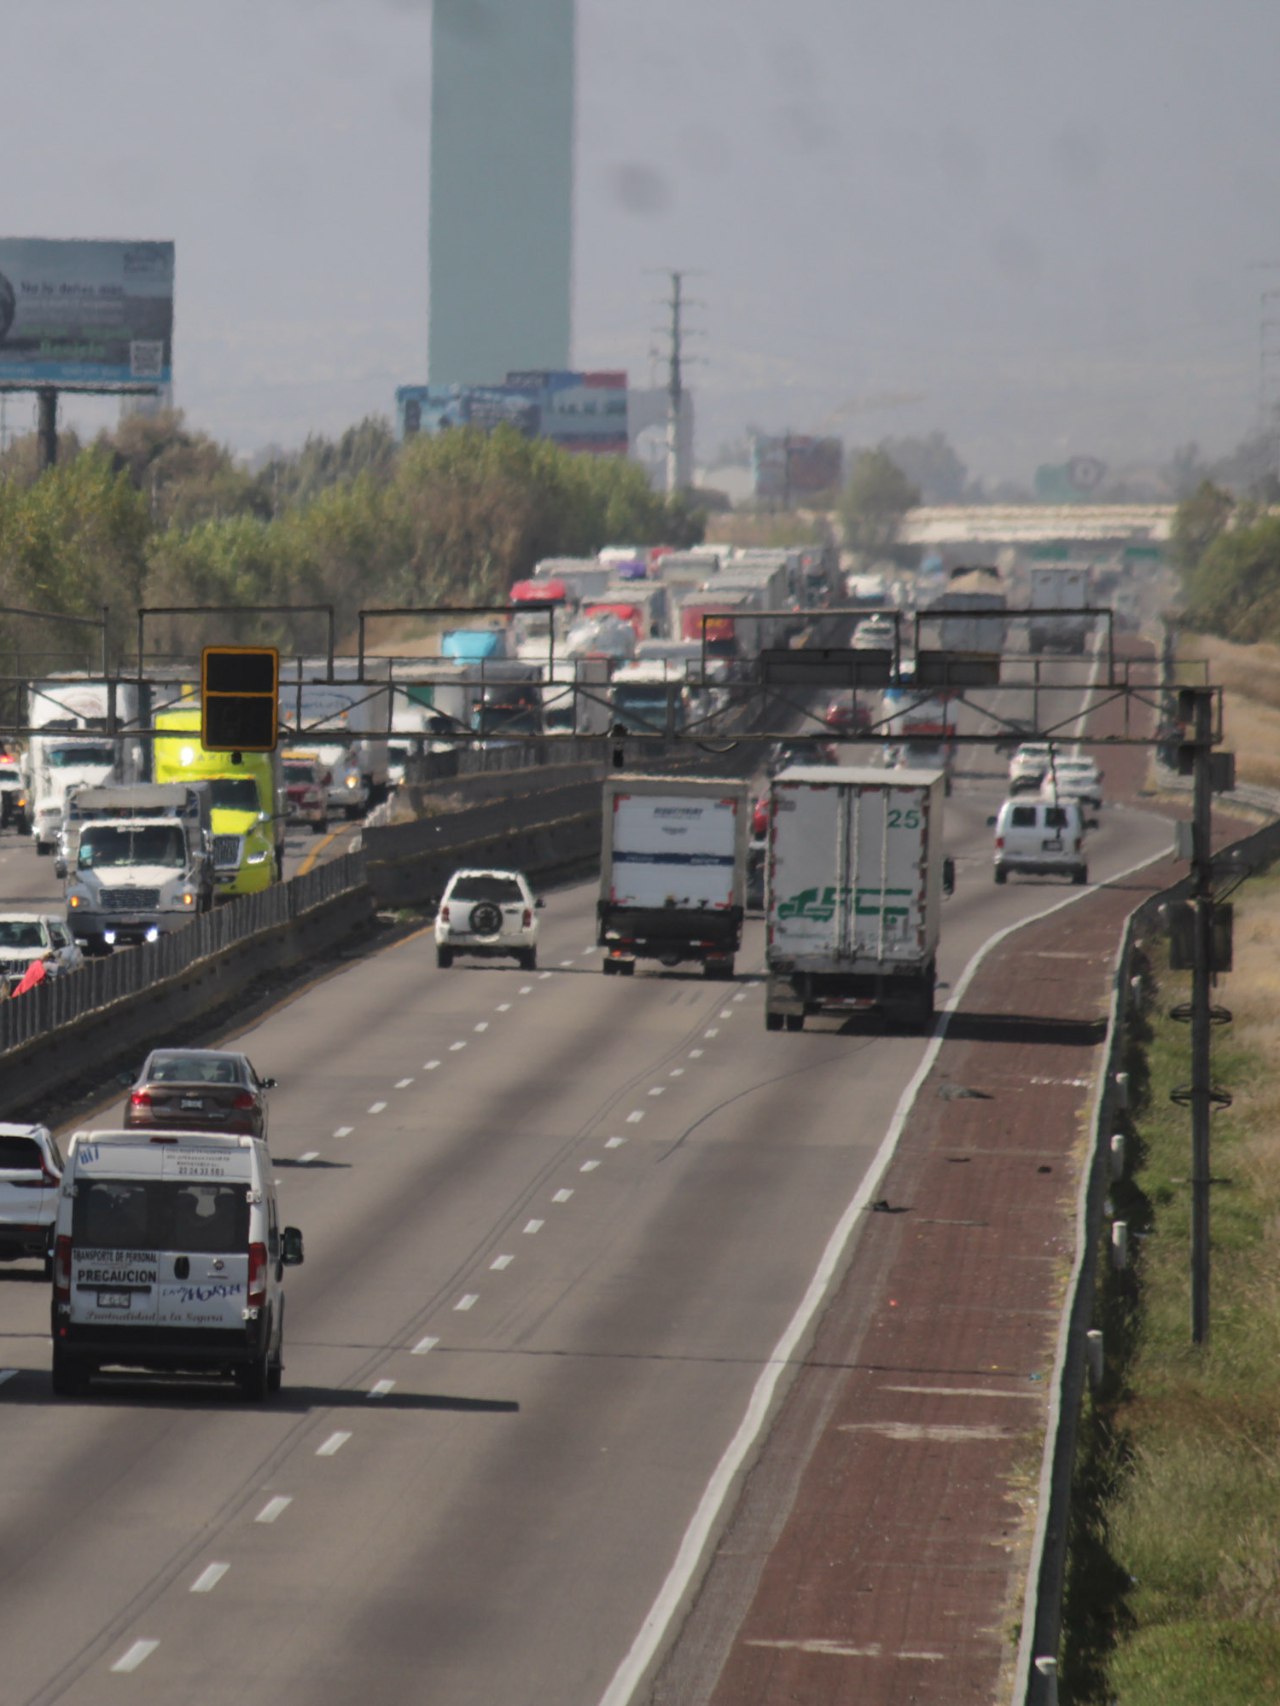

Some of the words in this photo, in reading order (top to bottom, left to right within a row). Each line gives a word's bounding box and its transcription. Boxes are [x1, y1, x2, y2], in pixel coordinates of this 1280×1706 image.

[887, 810, 920, 829] 25
[73, 1249, 114, 1262] TRANSPORTE
[116, 1250, 124, 1262] DE
[126, 1251, 158, 1263] PERSONAL
[78, 1269, 157, 1283] PRECAUCION
